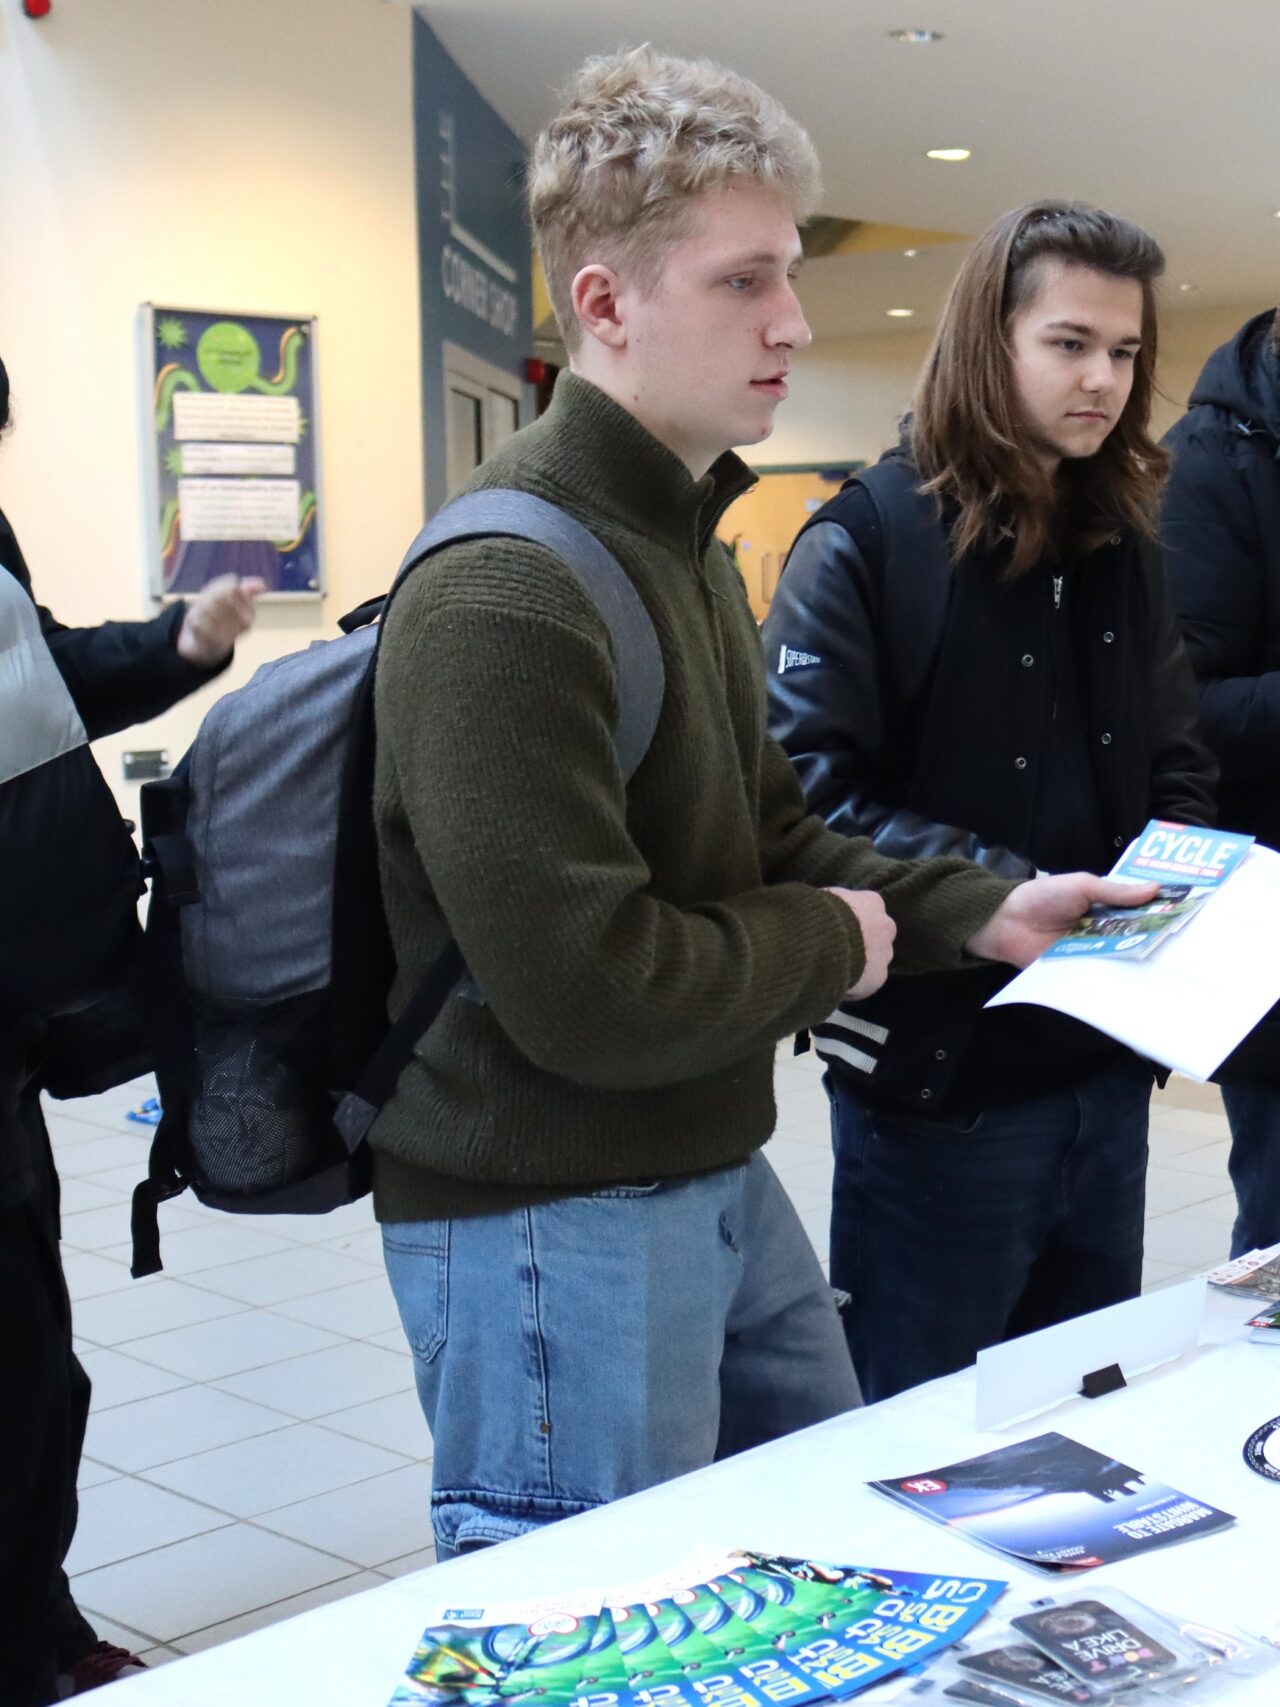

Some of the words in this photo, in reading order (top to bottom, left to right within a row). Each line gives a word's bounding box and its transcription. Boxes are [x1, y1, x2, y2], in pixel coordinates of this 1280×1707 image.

[1139, 830, 1237, 870] CYCLE
[913, 1479, 943, 1493] EK
[1113, 1502, 1197, 1535] WHITSTABLE
[1150, 1506, 1213, 1534] MARGATE
[1074, 1637, 1141, 1662] DRIVE
[1083, 1629, 1129, 1648] LIKE
